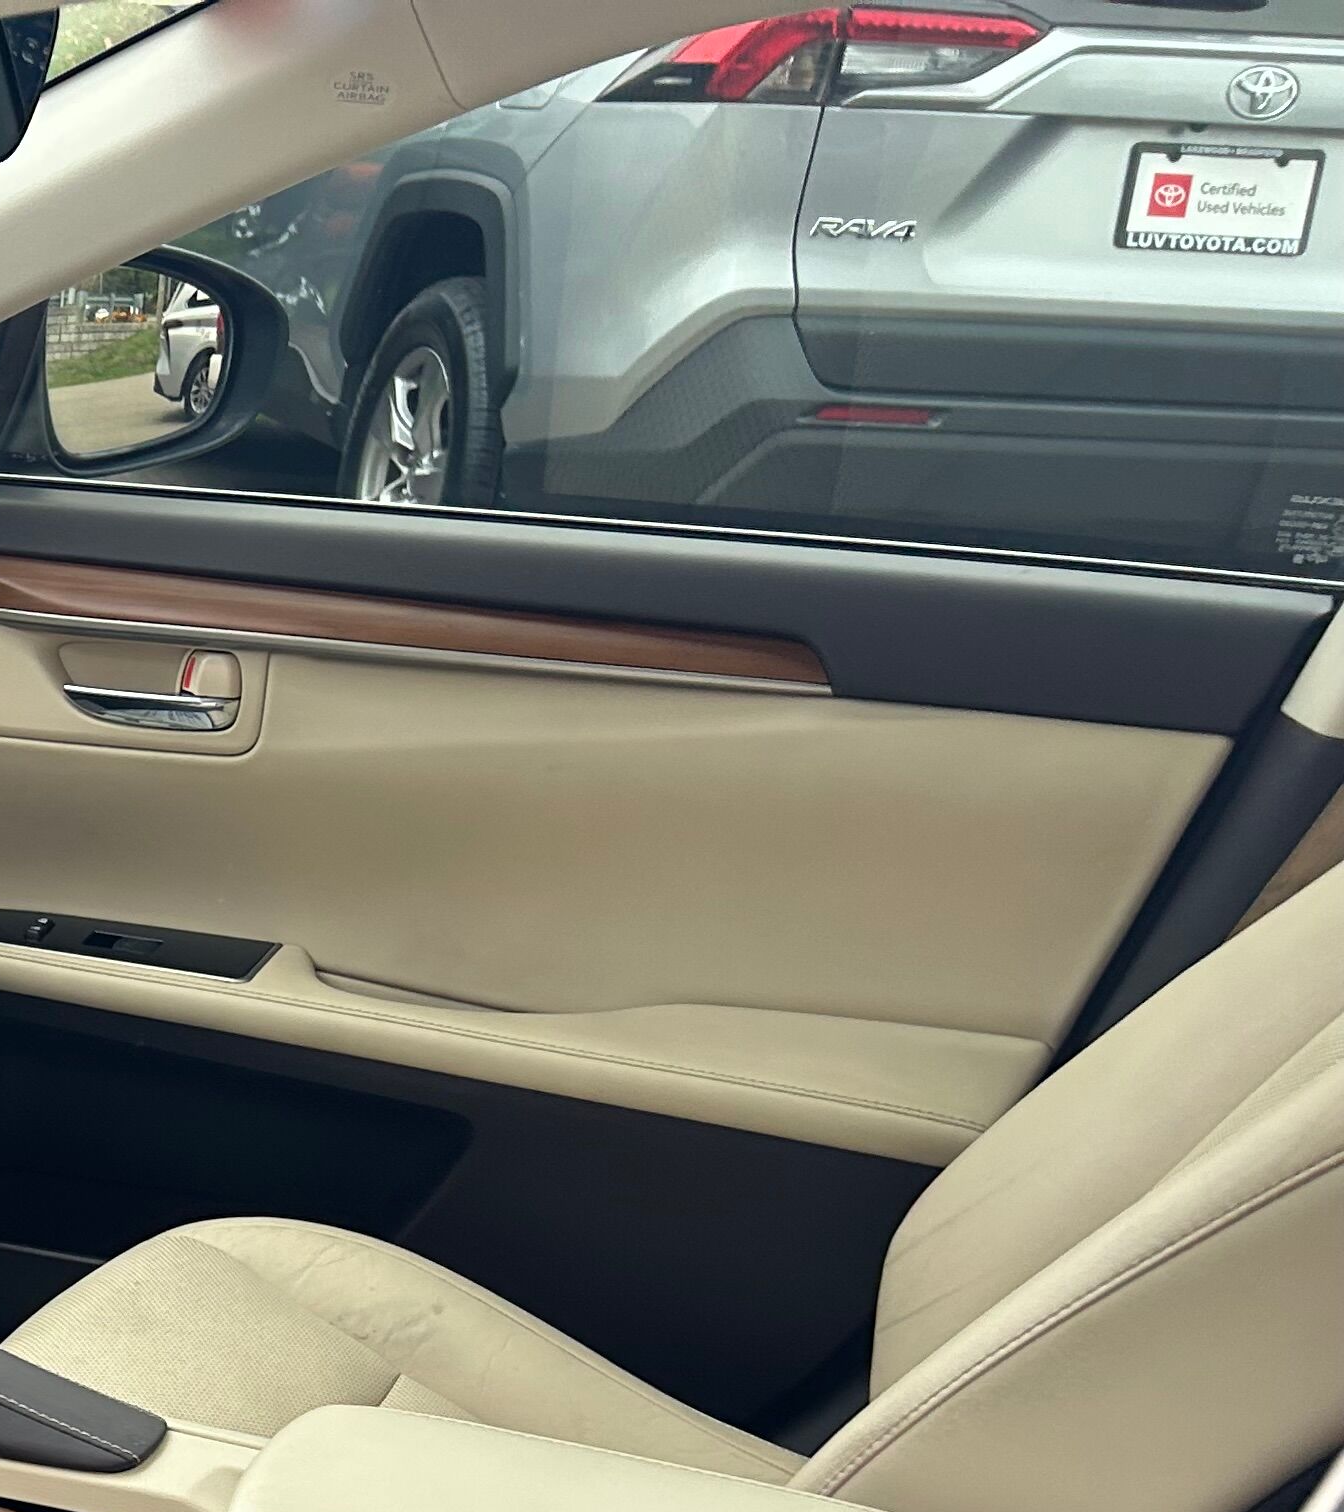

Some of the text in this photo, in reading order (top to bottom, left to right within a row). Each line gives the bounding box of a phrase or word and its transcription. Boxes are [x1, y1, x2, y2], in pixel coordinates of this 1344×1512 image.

[333, 81, 389, 94] CURTAIN
[336, 91, 386, 102] AIRBAG
[1200, 181, 1257, 198] Certified
[1197, 201, 1286, 218] Used Vehicles
[810, 216, 917, 243] RAV4
[1126, 231, 1300, 256] LUVTOYOTA.COM
